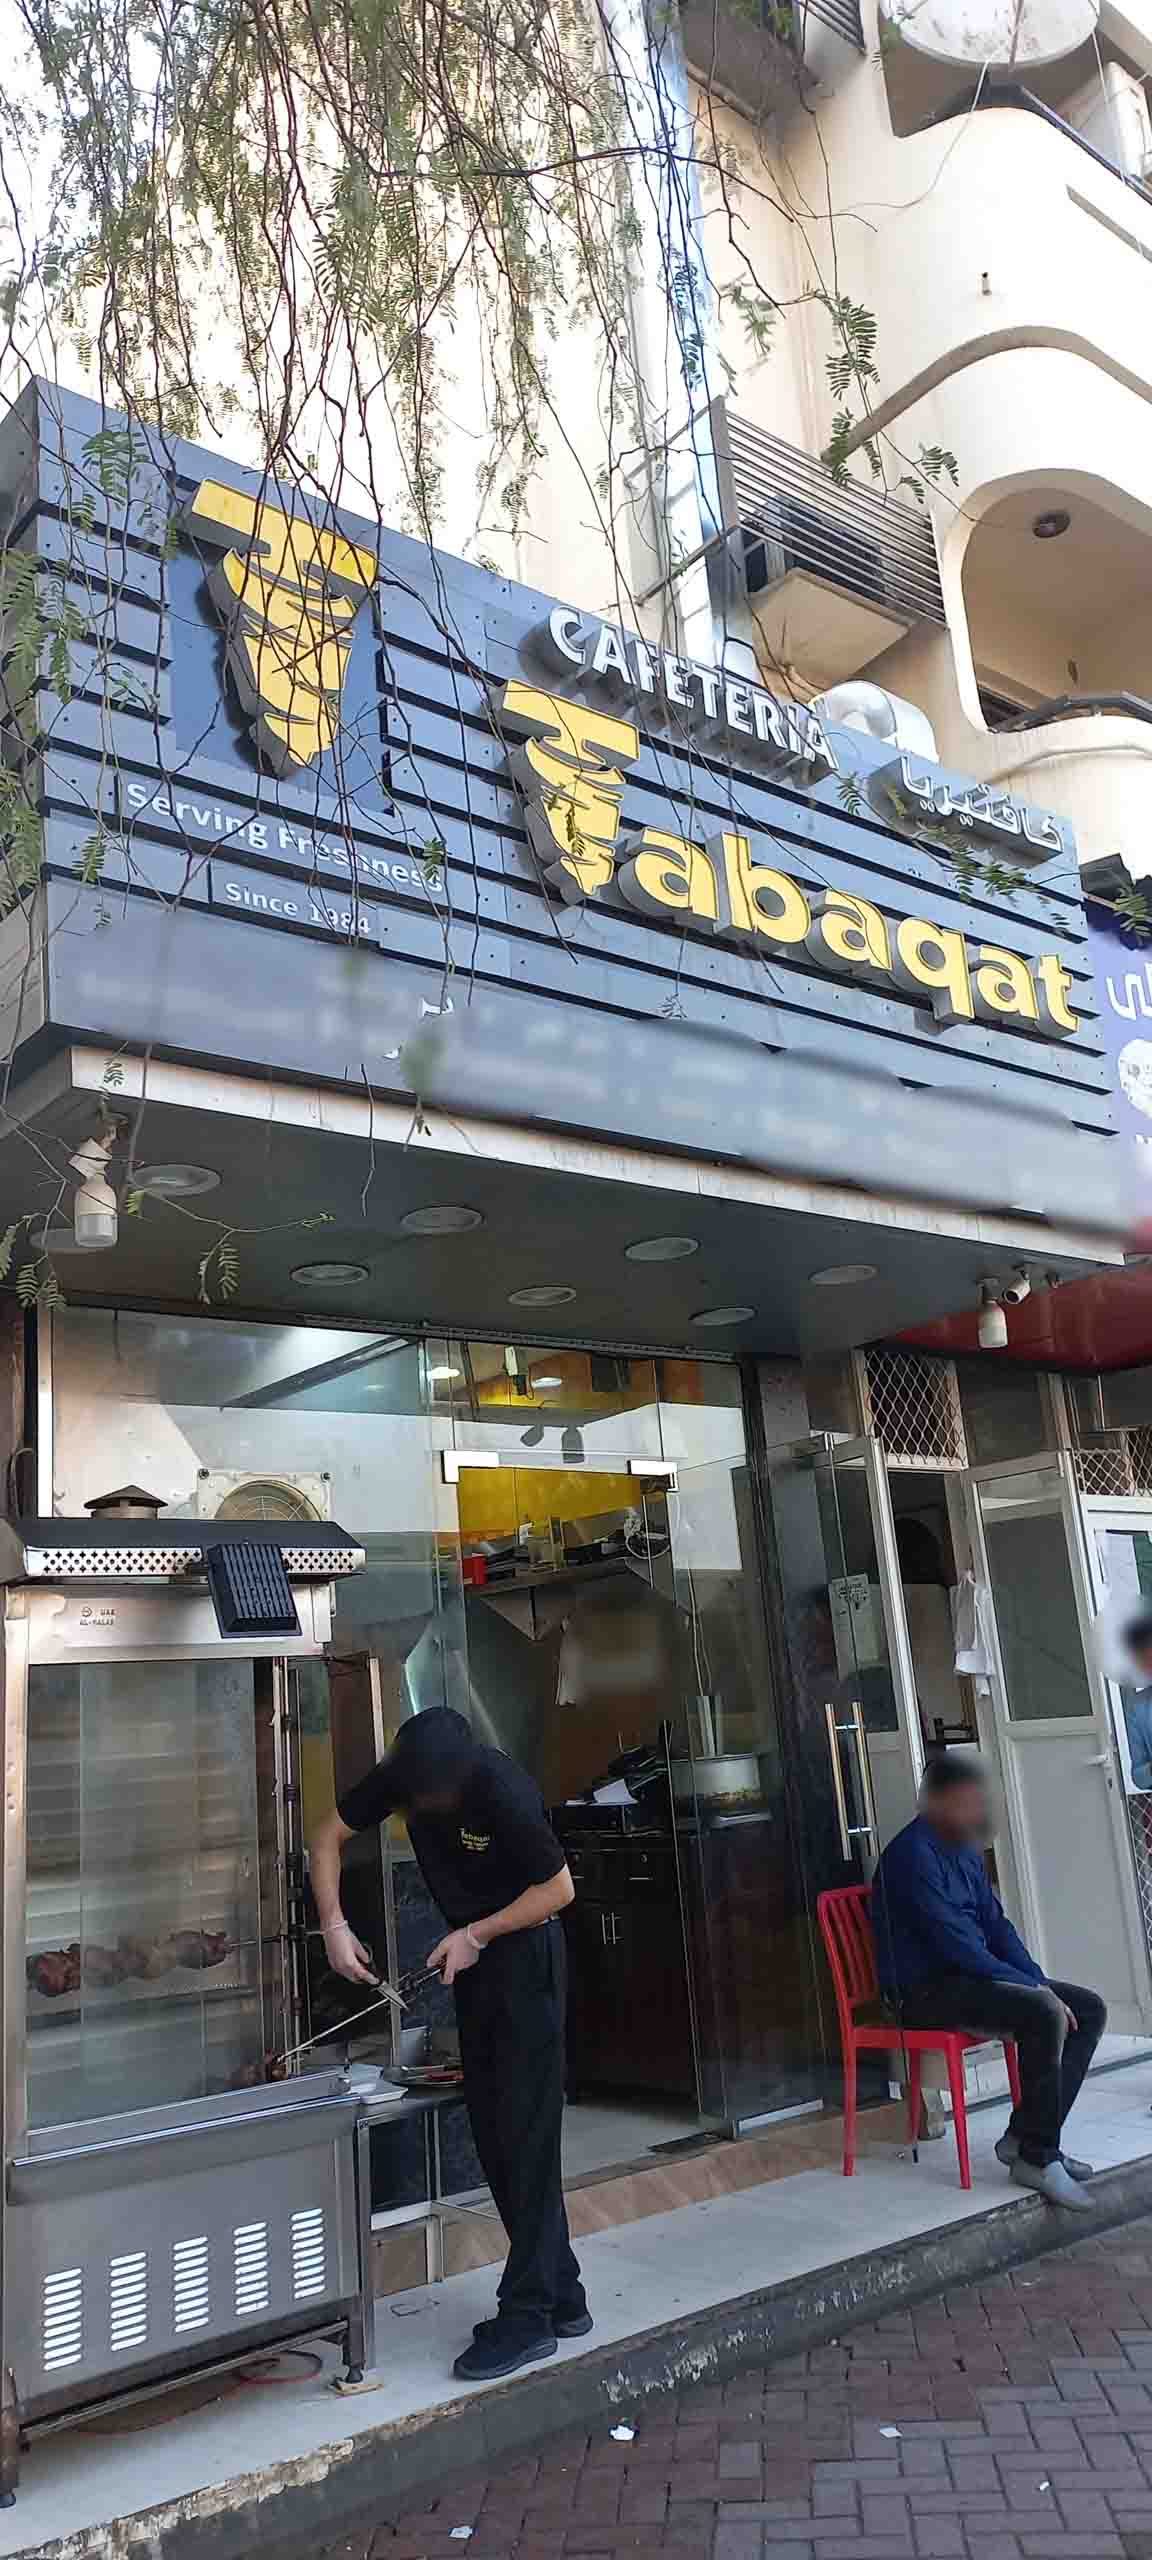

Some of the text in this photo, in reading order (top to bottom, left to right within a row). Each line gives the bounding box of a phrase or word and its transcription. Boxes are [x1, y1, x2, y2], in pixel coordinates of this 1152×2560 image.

[549, 604, 840, 771] CAFETERIA
[126, 782, 268, 850] Serving
[900, 754, 1064, 853] كافتيريا
[502, 679, 1079, 1032] Tabaqat
[225, 882, 372, 935] Since 1984
